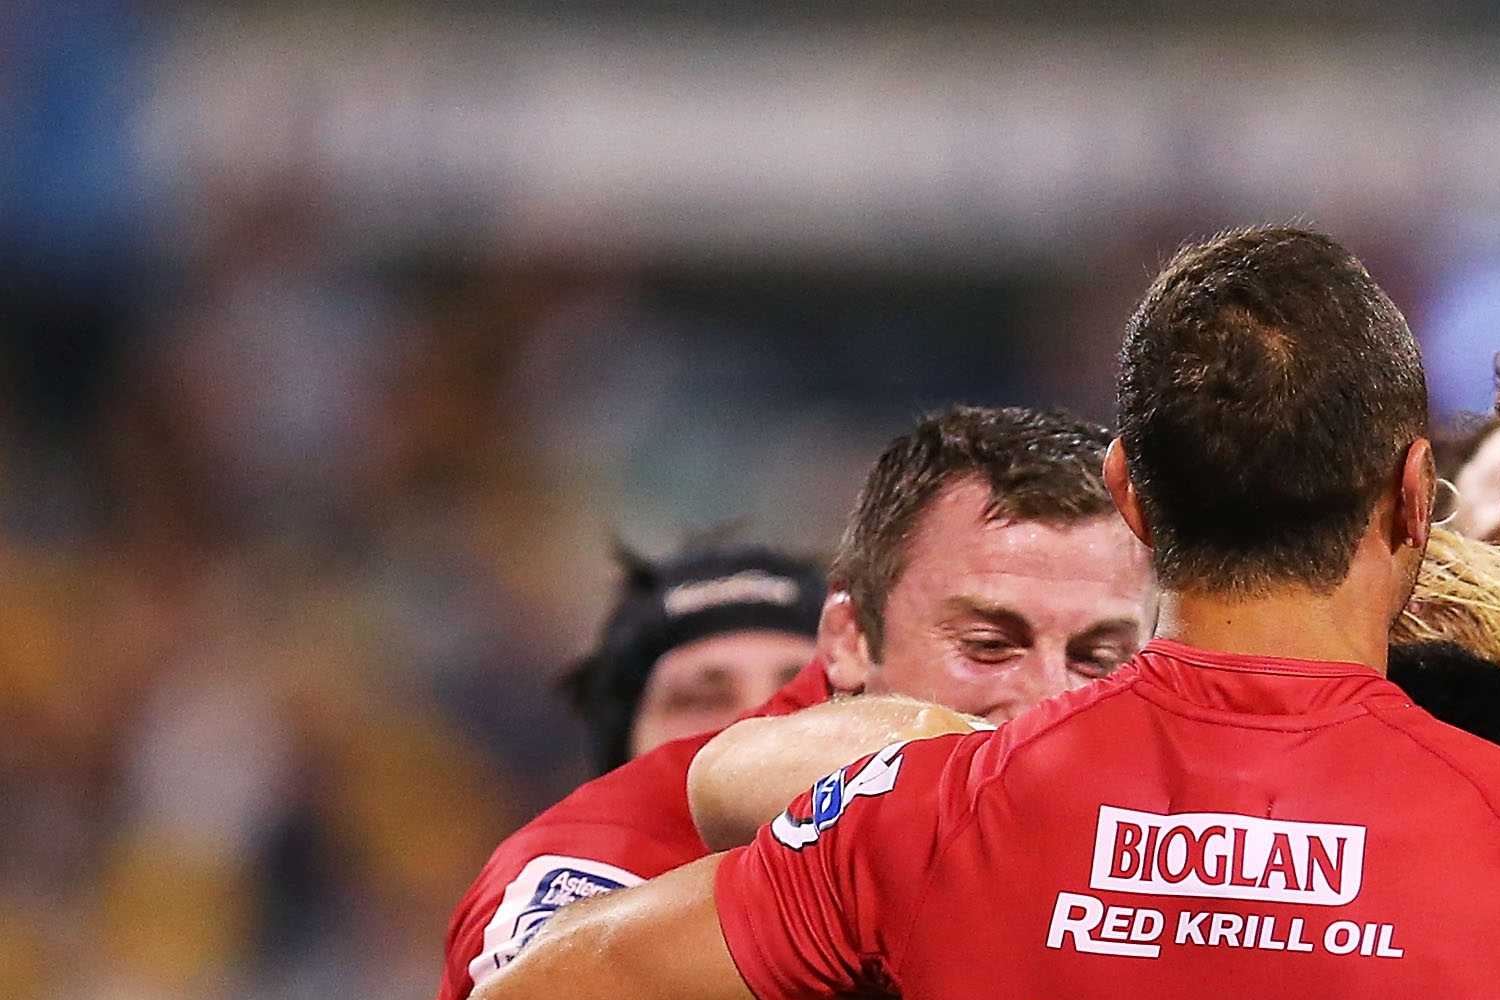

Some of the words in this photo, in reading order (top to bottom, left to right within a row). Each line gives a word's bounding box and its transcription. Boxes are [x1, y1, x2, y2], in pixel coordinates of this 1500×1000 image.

[1108, 820, 1348, 895] BIOGLAN
[1046, 891, 1164, 958] RED
[1174, 911, 1315, 952] KRILL
[1322, 920, 1405, 958] OIL
